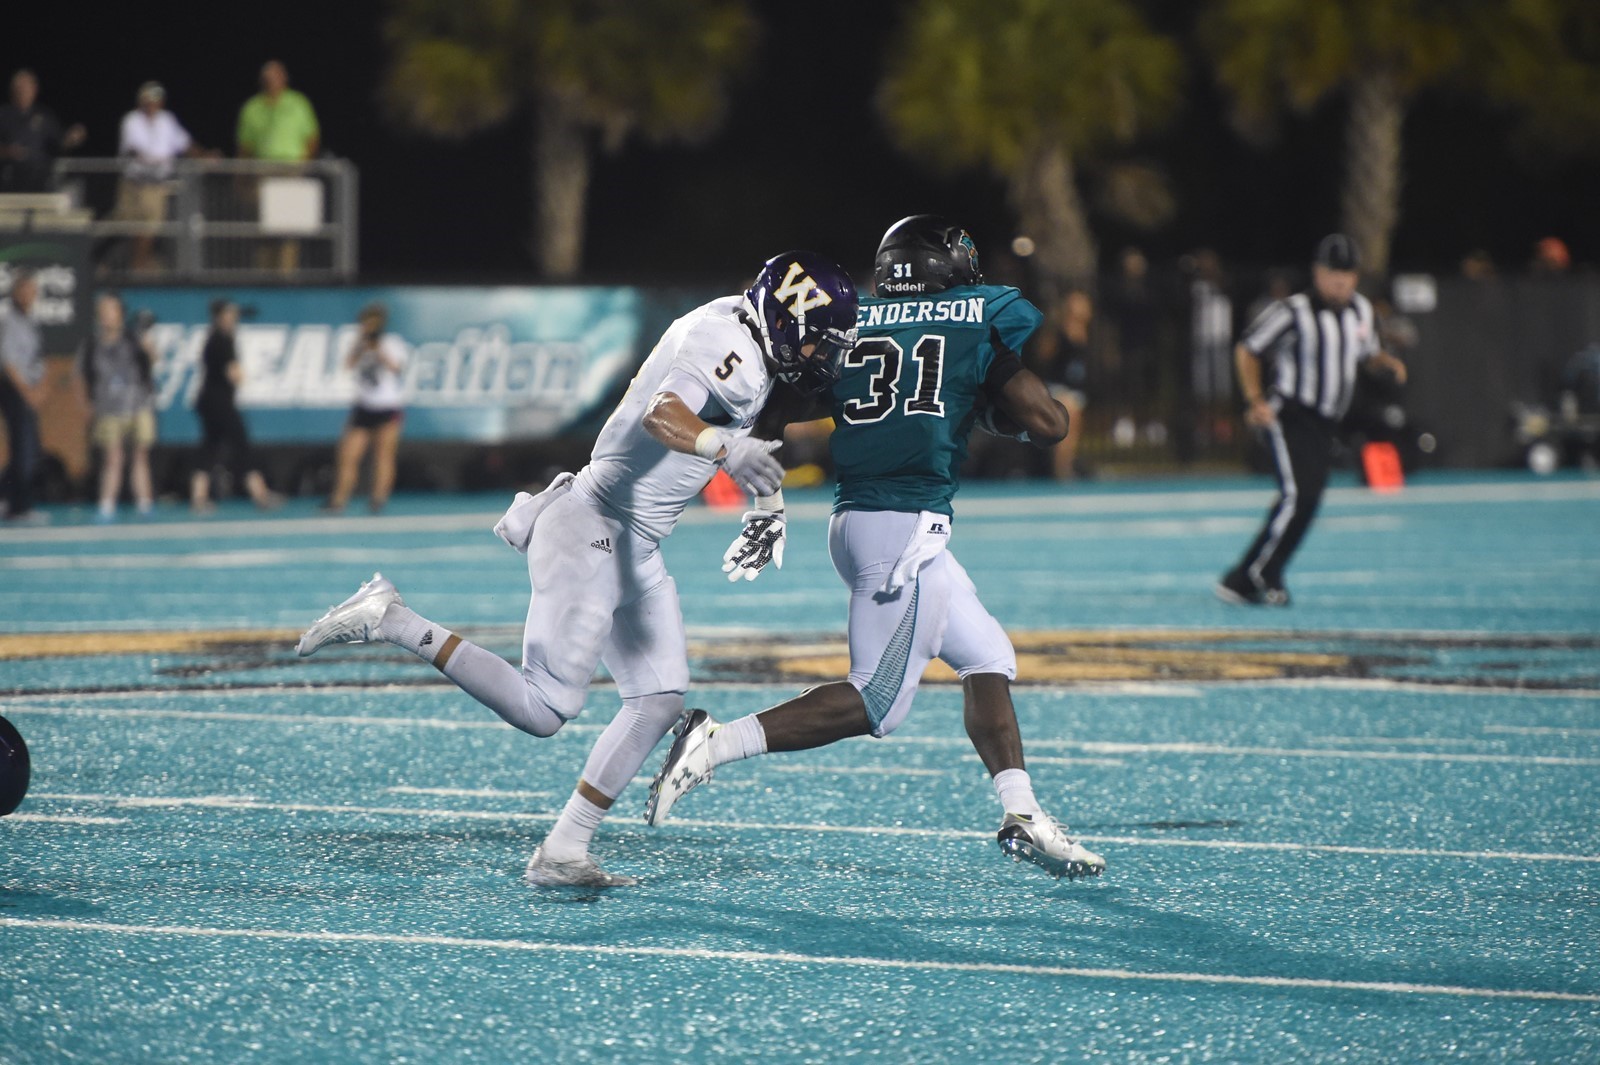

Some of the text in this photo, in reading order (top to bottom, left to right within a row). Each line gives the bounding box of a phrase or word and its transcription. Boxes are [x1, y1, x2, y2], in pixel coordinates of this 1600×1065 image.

[893, 262, 912, 278] 31
[857, 297, 985, 327] ENDERSON
[714, 350, 743, 381] 5
[842, 334, 946, 425] 31
[591, 542, 612, 553] adidas
